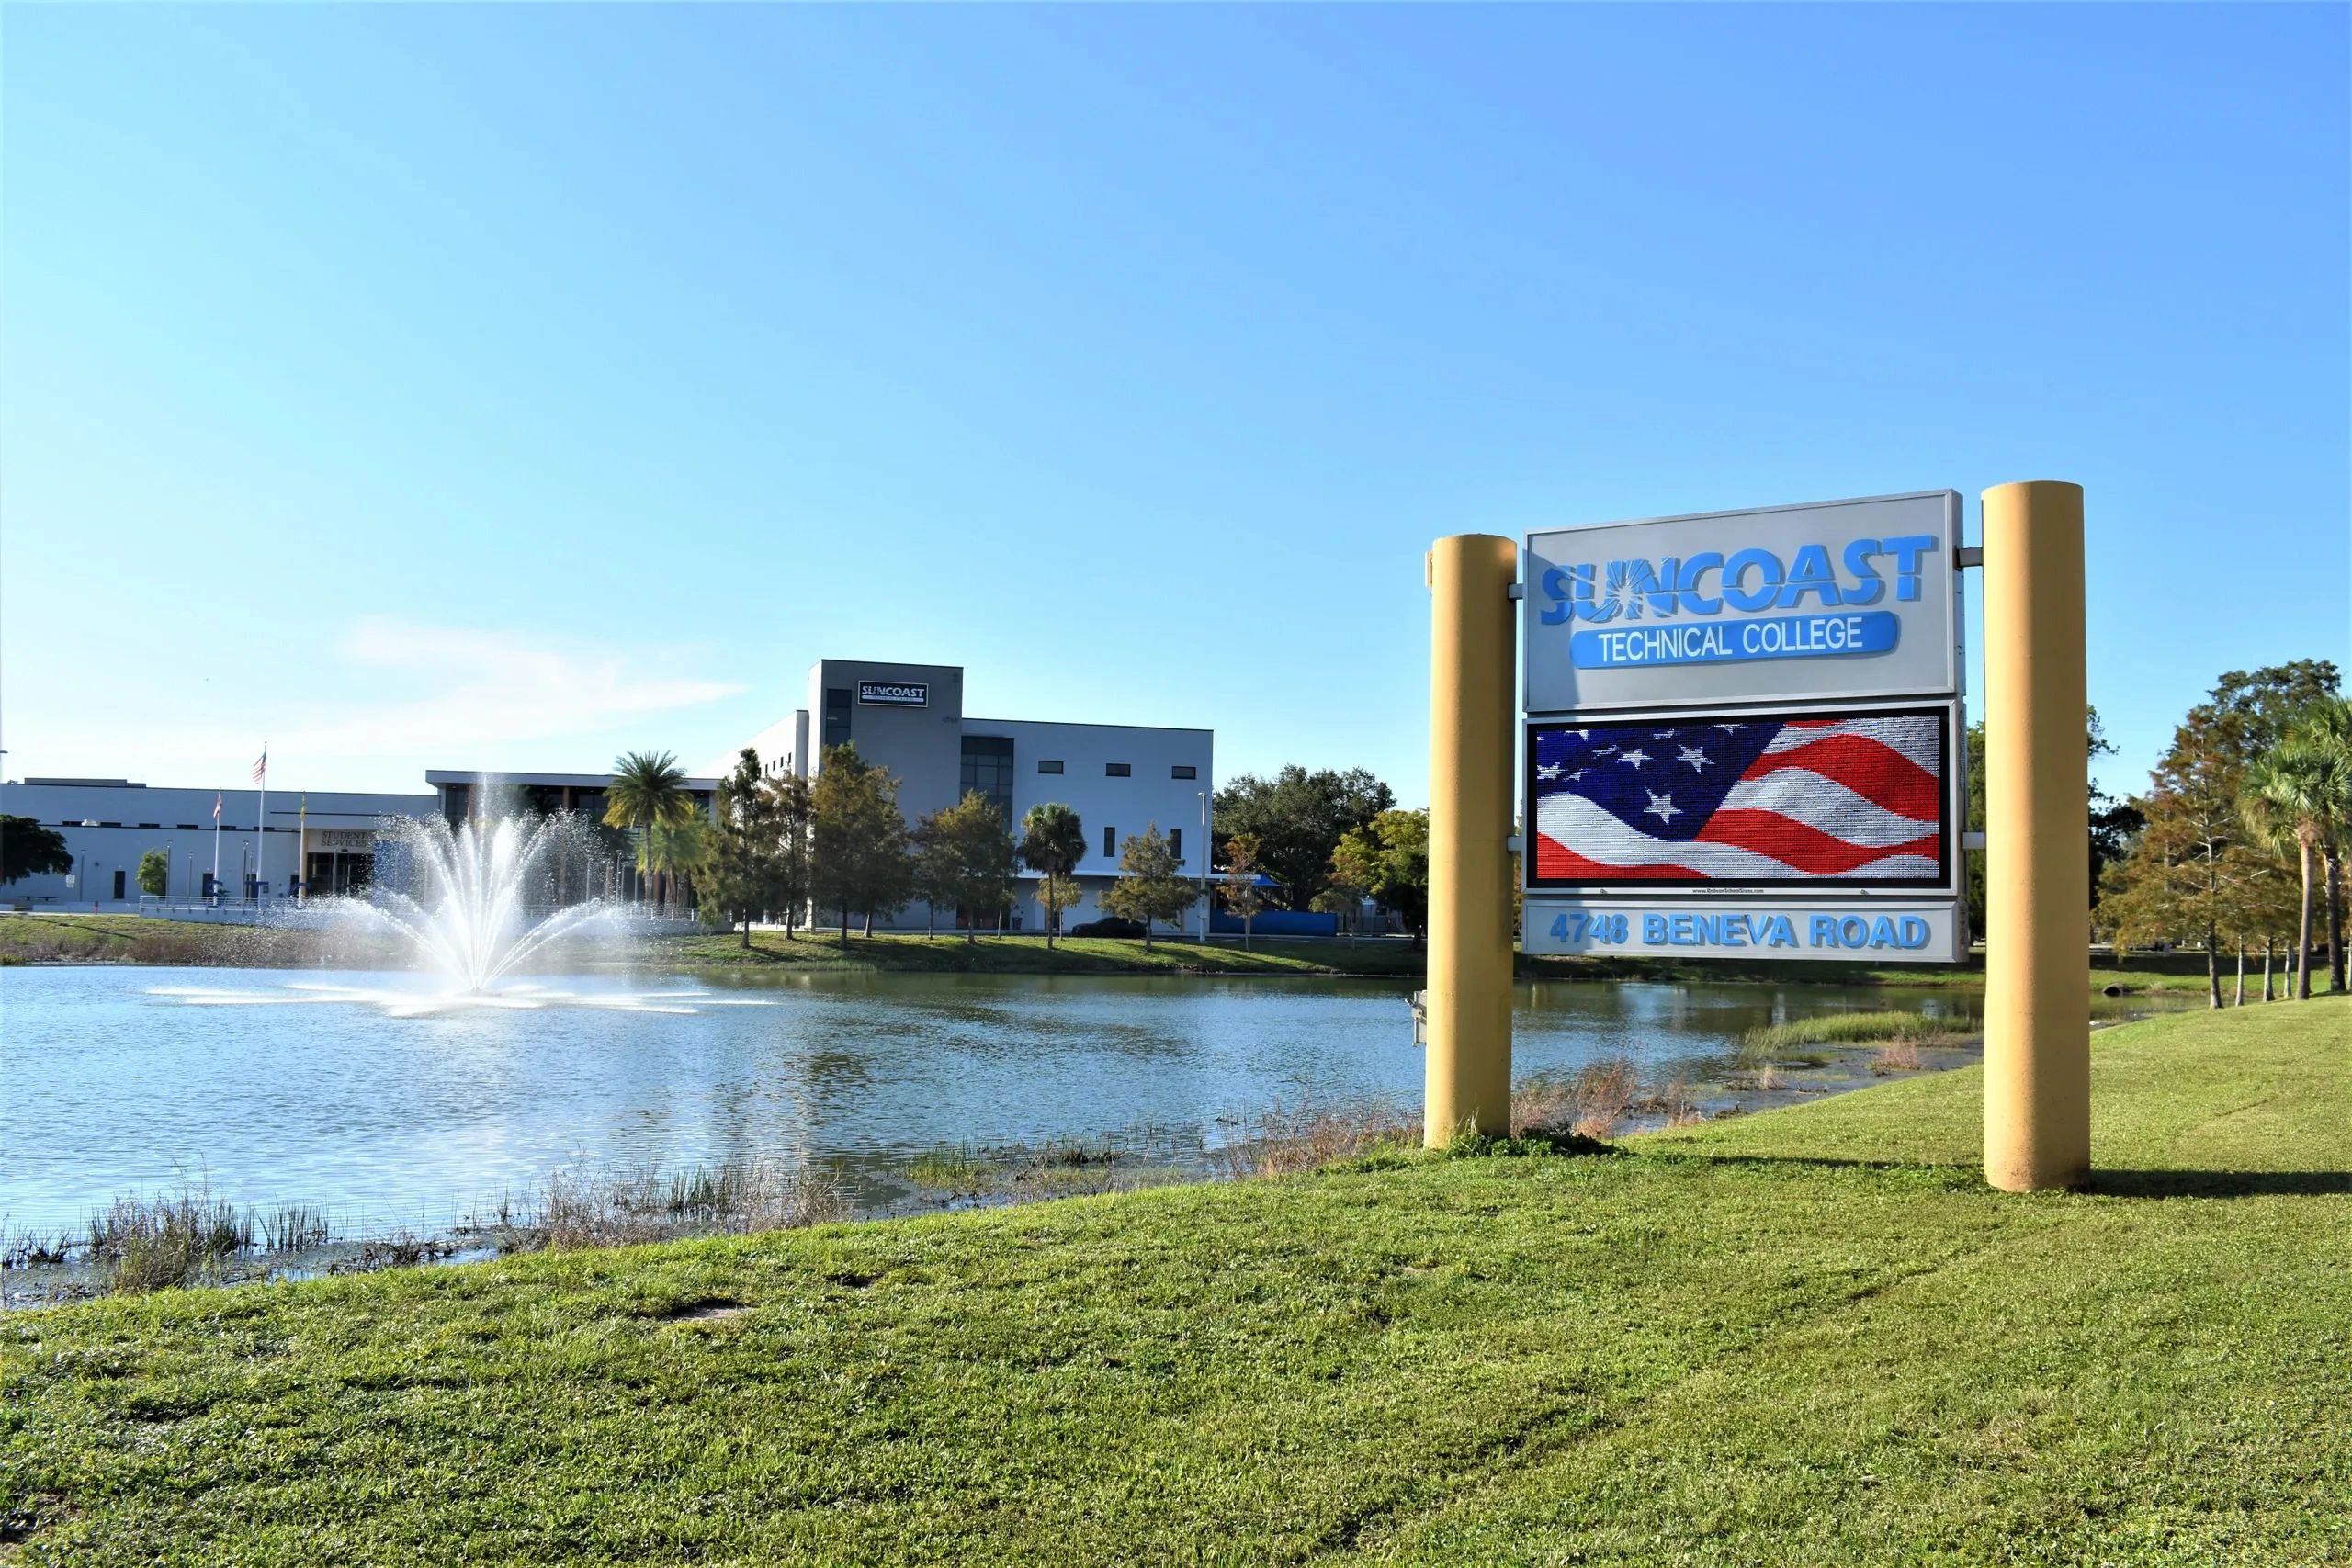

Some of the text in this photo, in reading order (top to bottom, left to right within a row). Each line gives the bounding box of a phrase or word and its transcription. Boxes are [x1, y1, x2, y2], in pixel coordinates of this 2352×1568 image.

[1541, 536, 1936, 625] SUNCOAST
[1598, 617, 1863, 662] TECHNICAL COLLEGE
[862, 686, 925, 698] SUNCOAST
[322, 830, 368, 840] STUDENT
[322, 839, 368, 847] SERVICES
[1550, 913, 1927, 948] 4748 BENEVA ROAD
